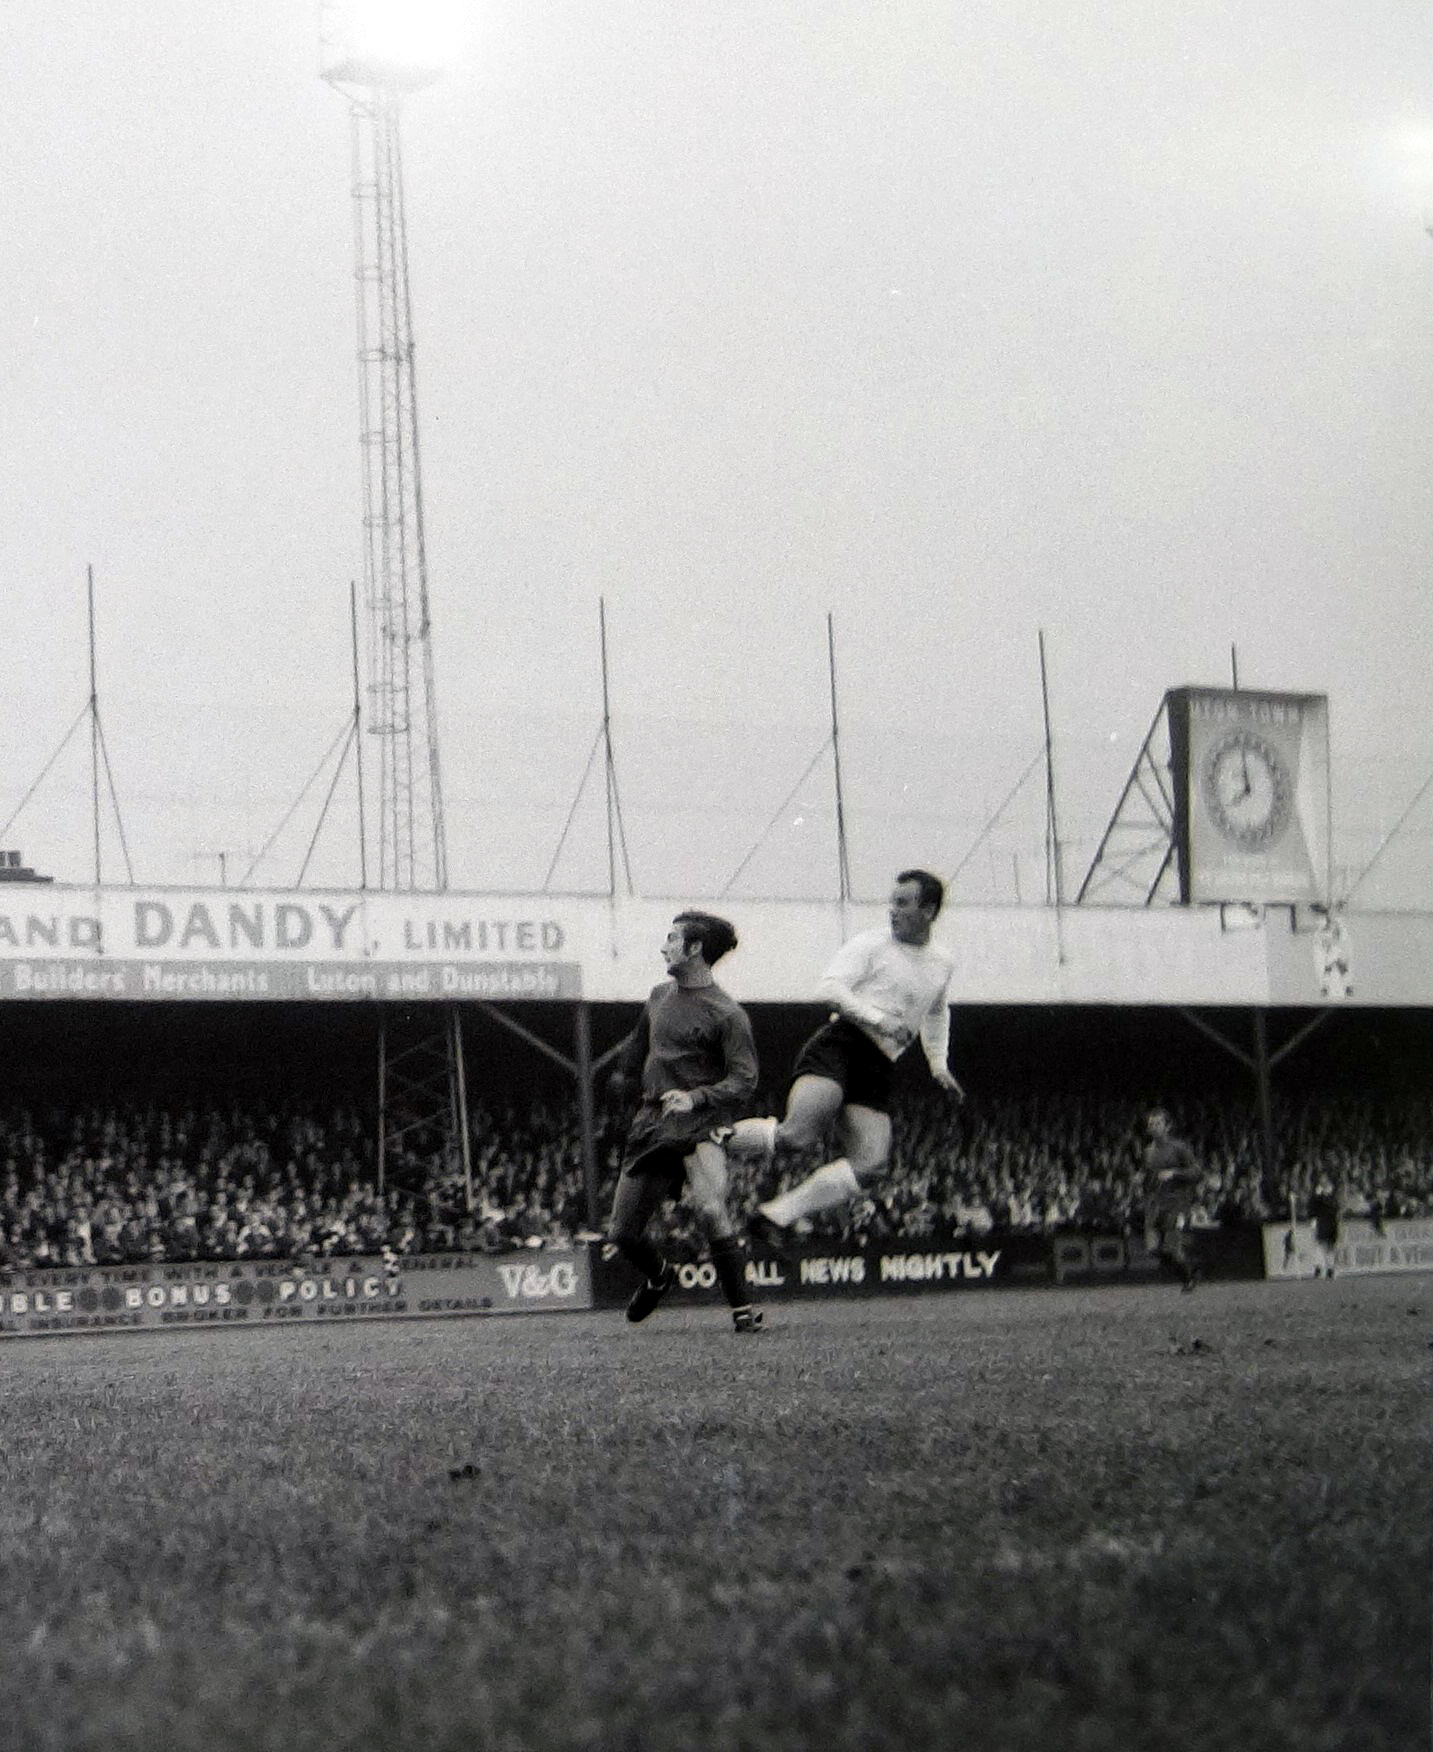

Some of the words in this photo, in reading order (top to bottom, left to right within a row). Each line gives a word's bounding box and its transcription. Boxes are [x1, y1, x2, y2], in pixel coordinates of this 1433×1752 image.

[403, 919, 566, 952] LIMITED
[143, 964, 269, 992] Merchants
[307, 965, 376, 993] Luton
[386, 968, 430, 993] and
[390, 1255, 478, 1272] ENERAL
[799, 1255, 866, 1287] NEWS
[880, 1249, 1003, 1283] NIGHTLY
[125, 1284, 232, 1308] BONUS
[279, 1278, 401, 1302] POLICY
[495, 1261, 580, 1299] V&G
